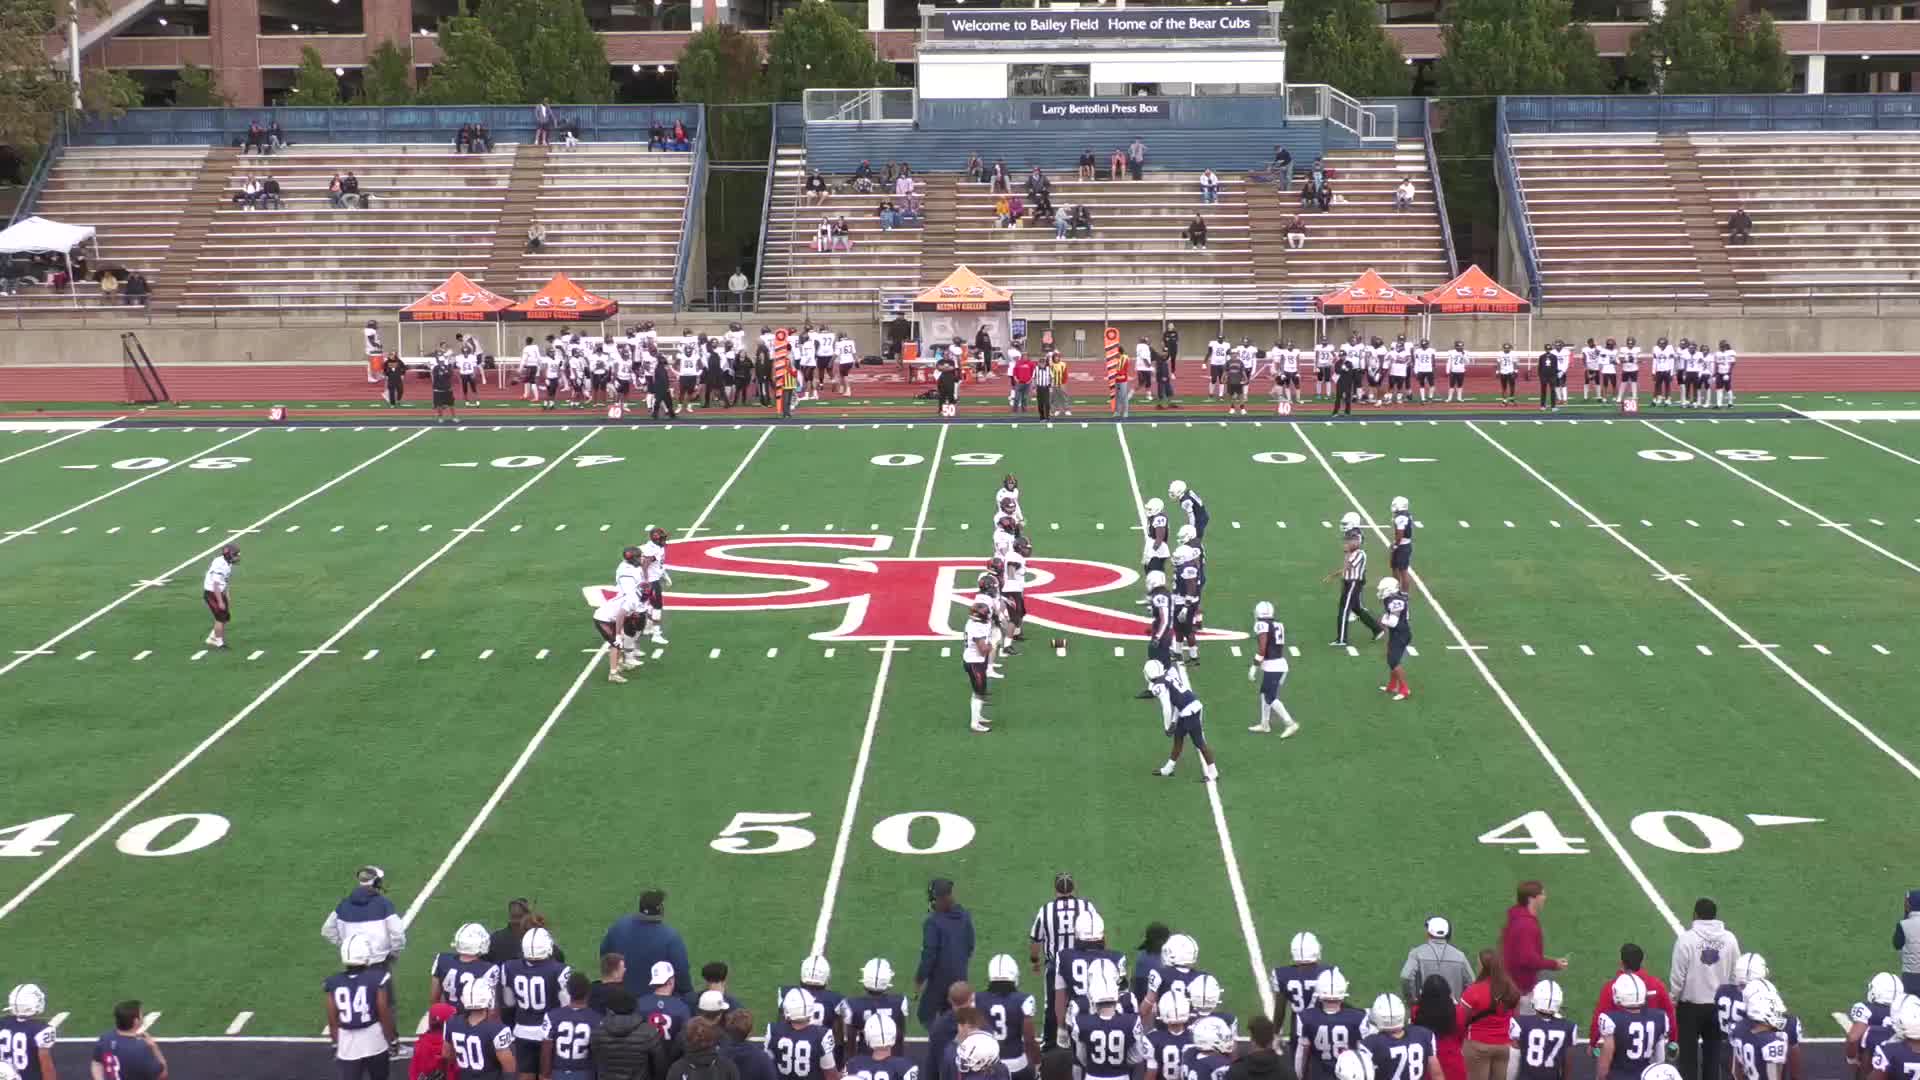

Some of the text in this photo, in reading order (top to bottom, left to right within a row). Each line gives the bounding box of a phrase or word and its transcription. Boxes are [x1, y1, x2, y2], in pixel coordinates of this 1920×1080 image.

[952, 17, 1250, 32] Welcome to Bailey Field Home of the Bear Cubs
[1042, 103, 1159, 116] Larry Bertolini Press Box
[942, 405, 955, 416] 50
[1624, 400, 1637, 411] 30
[583, 534, 1249, 641] SR
[1058, 910, 1075, 935] H
[335, 985, 371, 1023] 94
[514, 975, 546, 1010] 90
[556, 1021, 591, 1060] 22
[990, 1004, 1007, 1041] 3
[1626, 1021, 1655, 1060] 31
[0, 1029, 28, 1071] 28
[452, 1032, 485, 1071] 50
[777, 1037, 811, 1077] 38
[1090, 1030, 1126, 1065] 39
[1314, 1025, 1349, 1060] 48
[1527, 1029, 1566, 1067] 87
[1769, 1045, 1784, 1057] 88
[1390, 1043, 1424, 1080] 78
